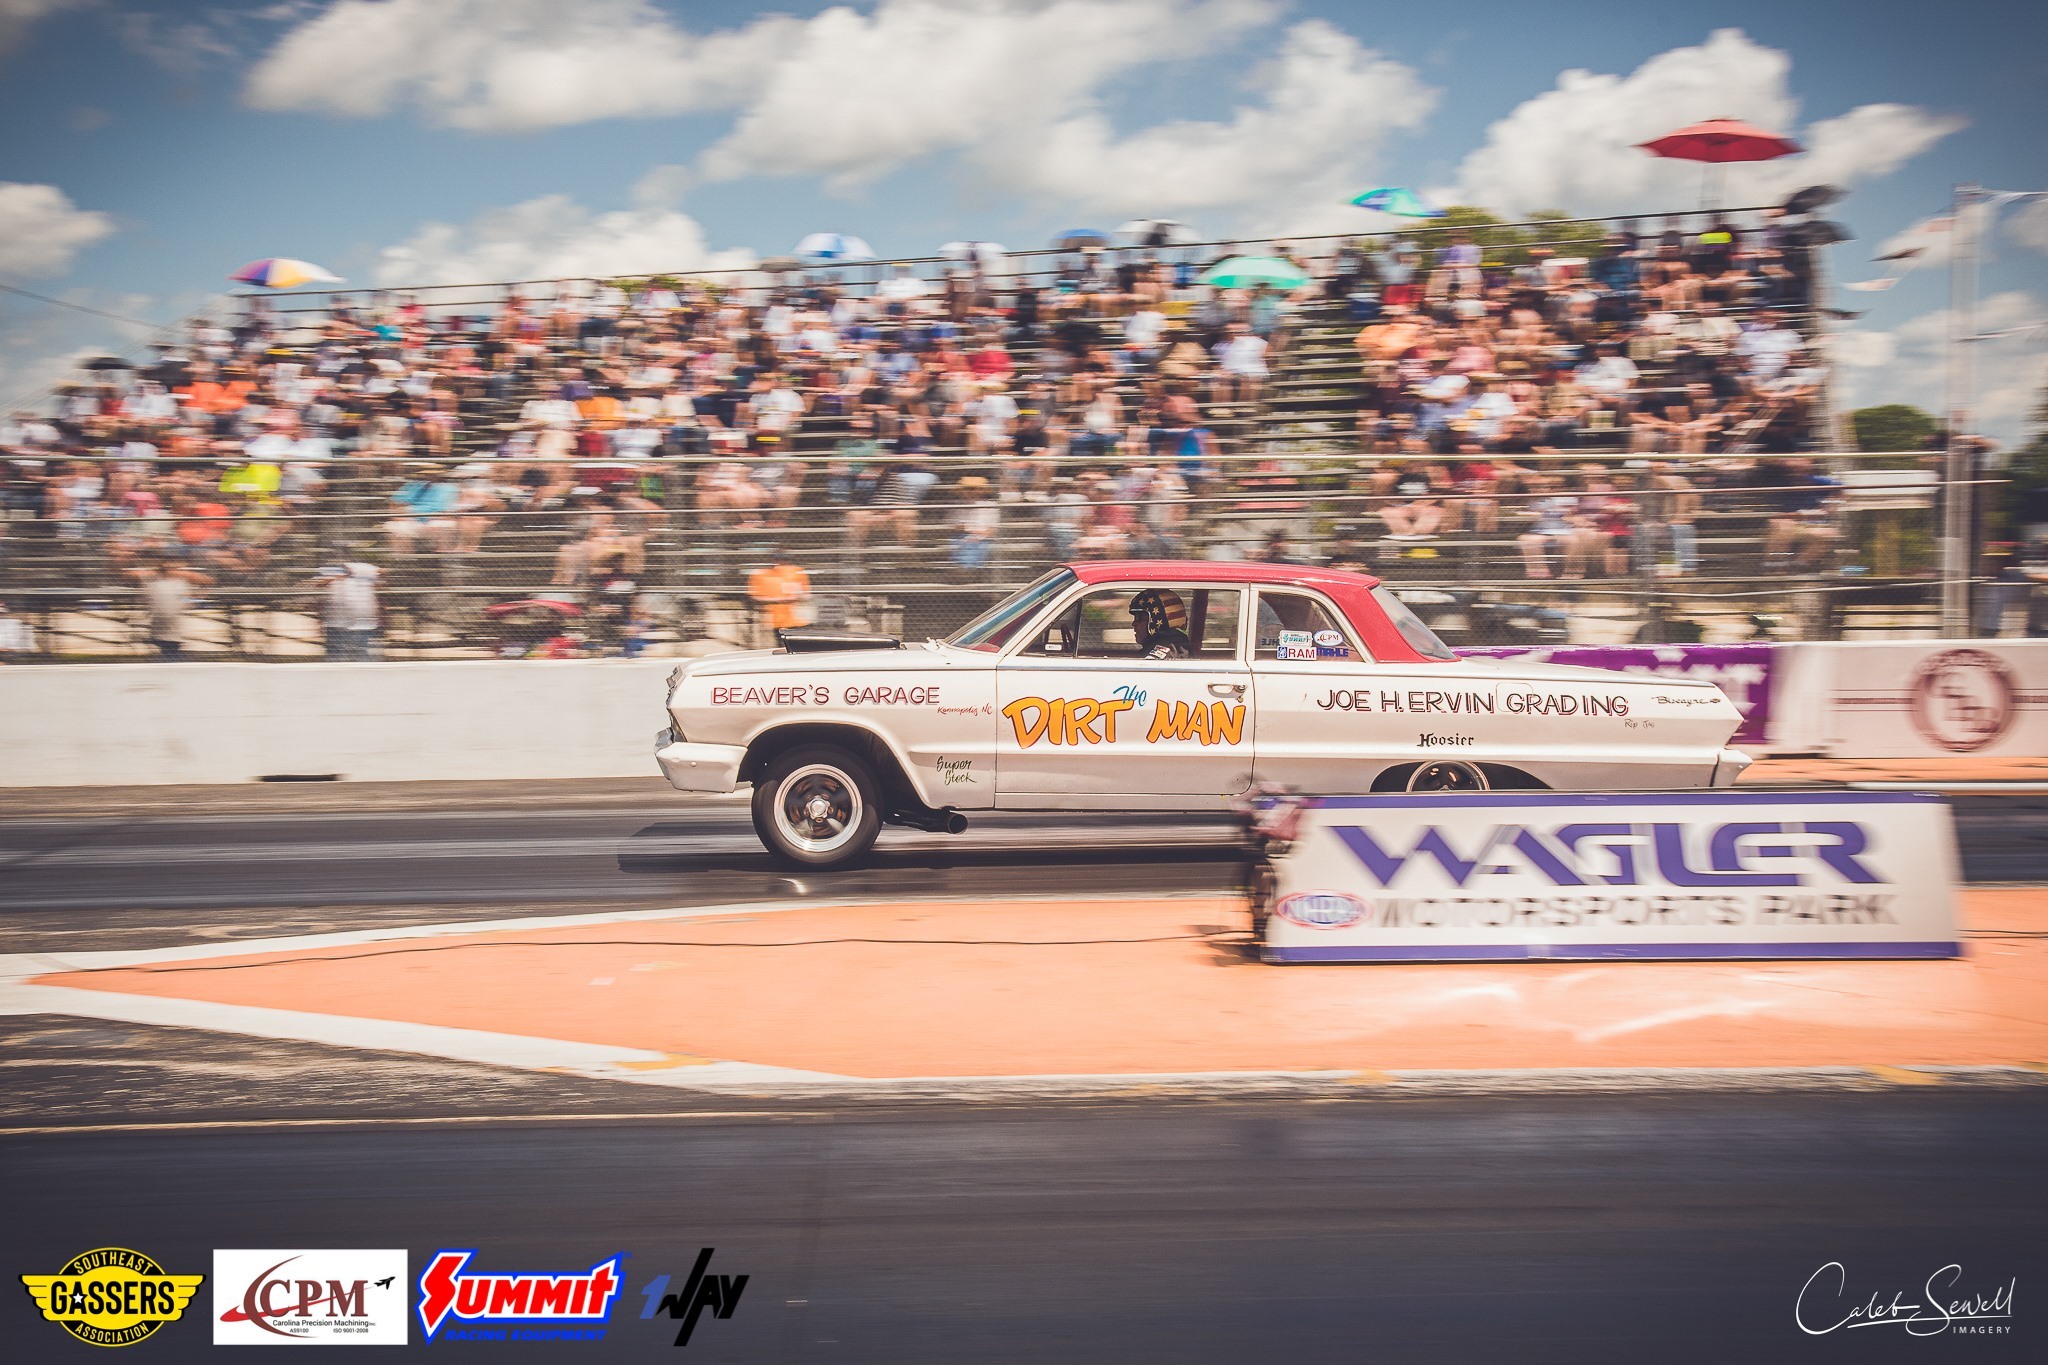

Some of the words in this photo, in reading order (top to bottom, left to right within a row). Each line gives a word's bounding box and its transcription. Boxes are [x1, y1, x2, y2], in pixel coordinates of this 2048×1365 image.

[1288, 648, 1315, 659] RAM
[1316, 647, 1349, 657] MAHLE
[711, 684, 830, 706] BEAVER'S
[843, 686, 940, 706] GARAGE
[1113, 684, 1147, 707] The
[1317, 689, 1372, 712] JOE
[1408, 691, 1495, 714] ERVIN
[1506, 693, 1630, 717] GRADING
[1001, 696, 1135, 750] DIRT
[1146, 699, 1247, 746] MAN
[1416, 732, 1475, 748] Hoosier
[936, 755, 973, 774] Super
[944, 769, 978, 786] Stock
[1330, 822, 1894, 888] WAGLER
[1372, 895, 1747, 928] MOTORSPORTS
[1755, 894, 1900, 926] PARK
